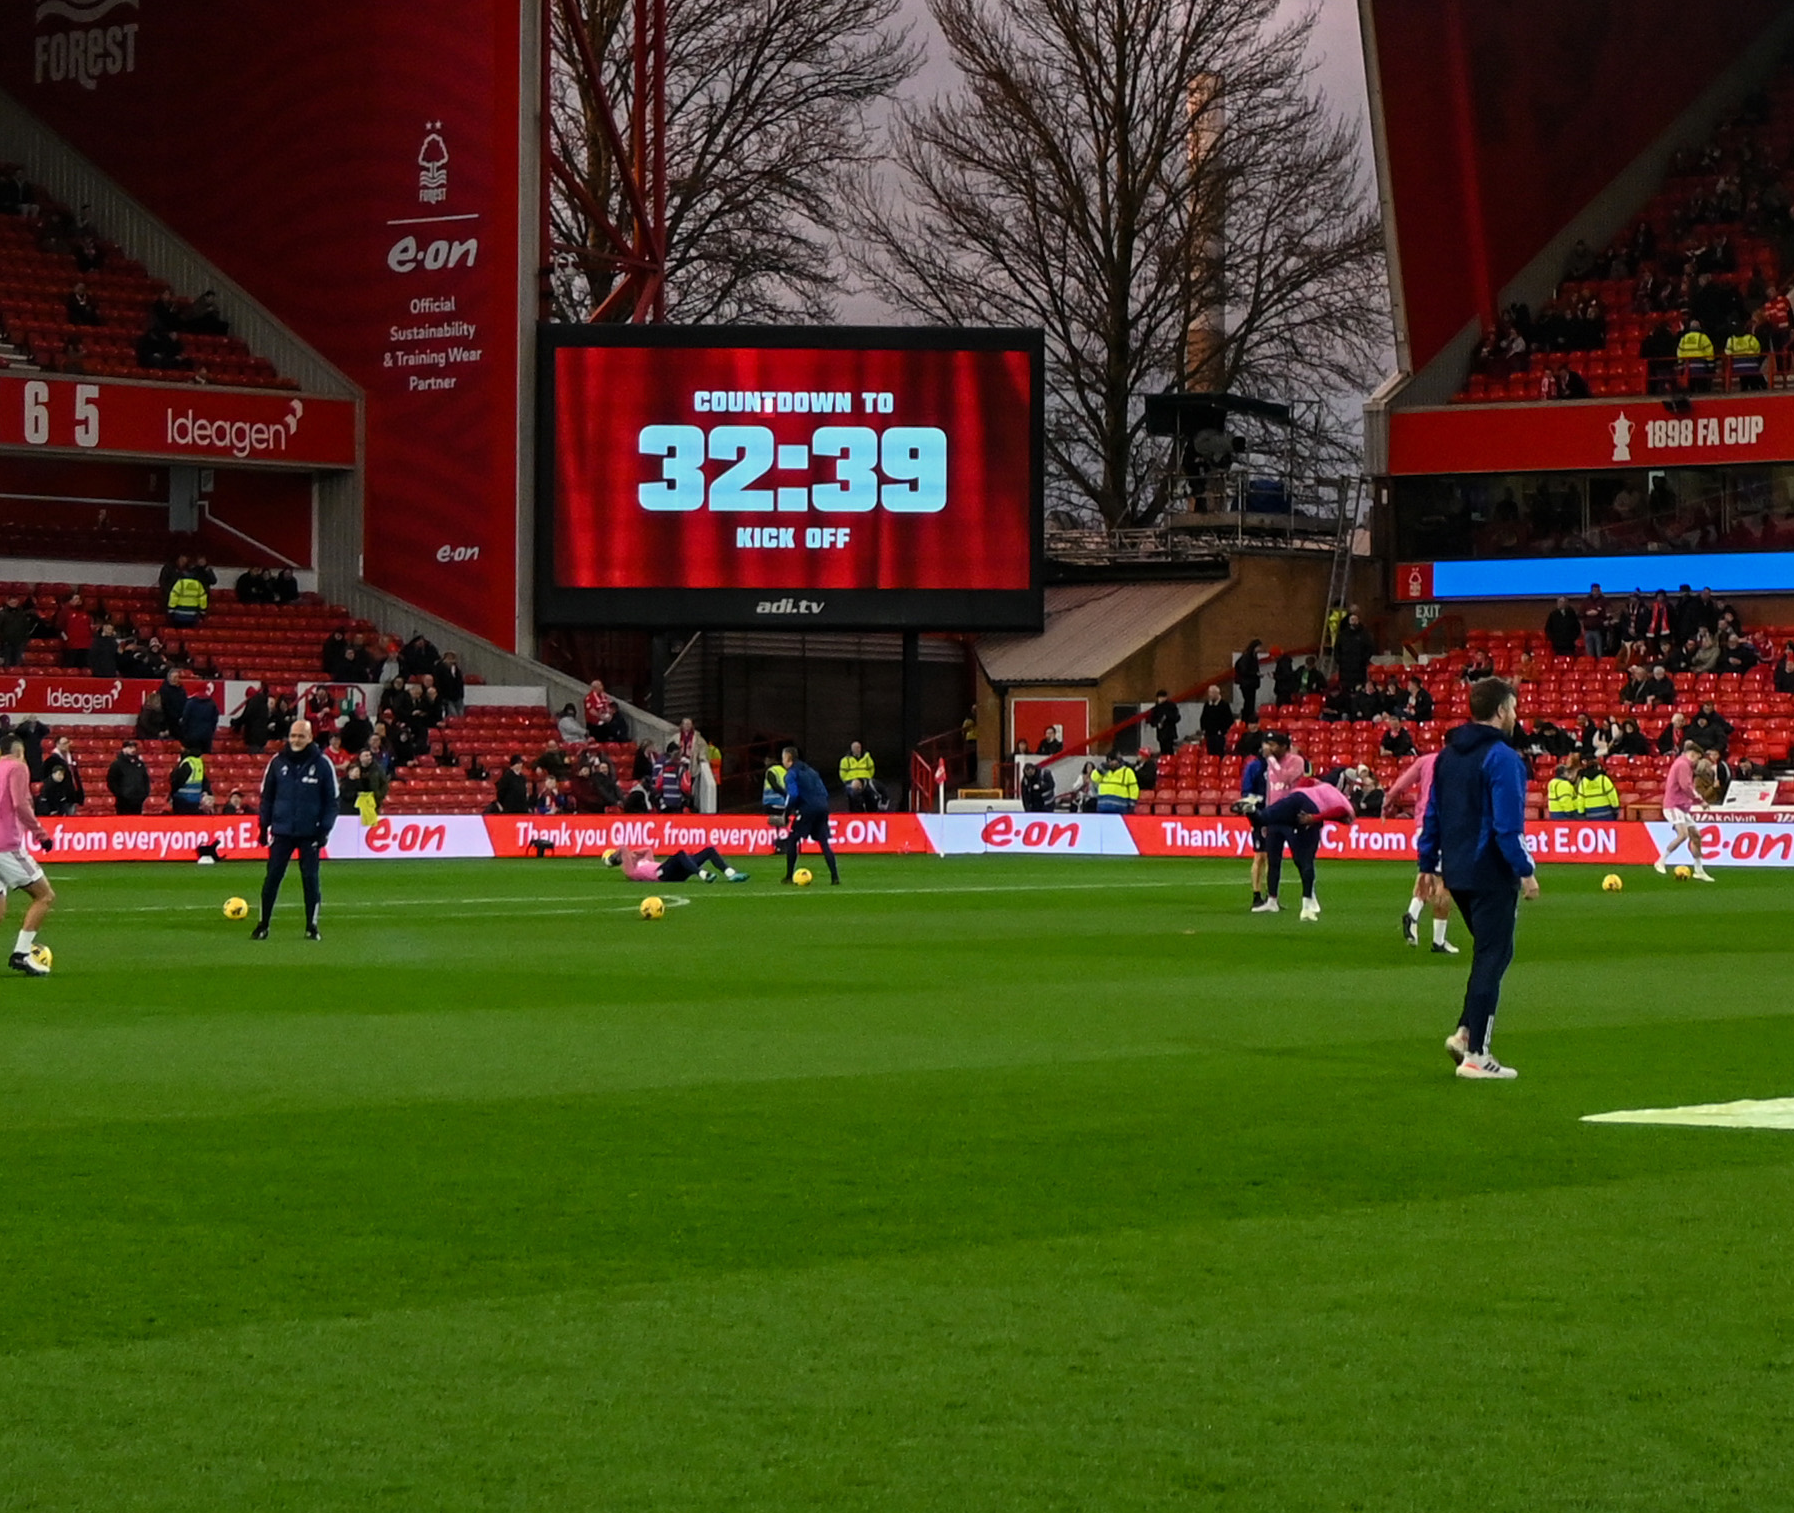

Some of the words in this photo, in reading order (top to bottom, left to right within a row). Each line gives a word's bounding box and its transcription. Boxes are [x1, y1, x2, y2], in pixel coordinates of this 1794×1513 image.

[410, 296, 455, 314] Official
[389, 321, 476, 341] Sustainability
[383, 352, 393, 367] &
[395, 349, 446, 368] Training
[448, 347, 482, 364] Wear
[409, 374, 456, 391] Partner
[694, 390, 851, 413] COUNTDOWN
[862, 392, 893, 413] TO
[167, 406, 287, 459] Ideagen
[1645, 419, 1693, 448] 1898
[1697, 418, 1720, 446] FA
[1724, 415, 1764, 444] CUP
[638, 424, 947, 513] 32:39
[736, 527, 795, 548] KICK
[806, 527, 850, 548] OFF
[756, 598, 825, 615] adi.tv
[1415, 604, 1441, 618] EXIT
[46, 686, 112, 712] Ideagen
[54, 824, 107, 852] from
[113, 828, 208, 858] everyone
[516, 822, 571, 847] Thank
[576, 827, 605, 853] you
[610, 821, 659, 850] QMC,
[663, 820, 705, 846] from
[828, 820, 886, 845] E.ON
[1162, 822, 1231, 848] Thank
[1349, 823, 1407, 850] from
[1554, 827, 1616, 854] E.ON
